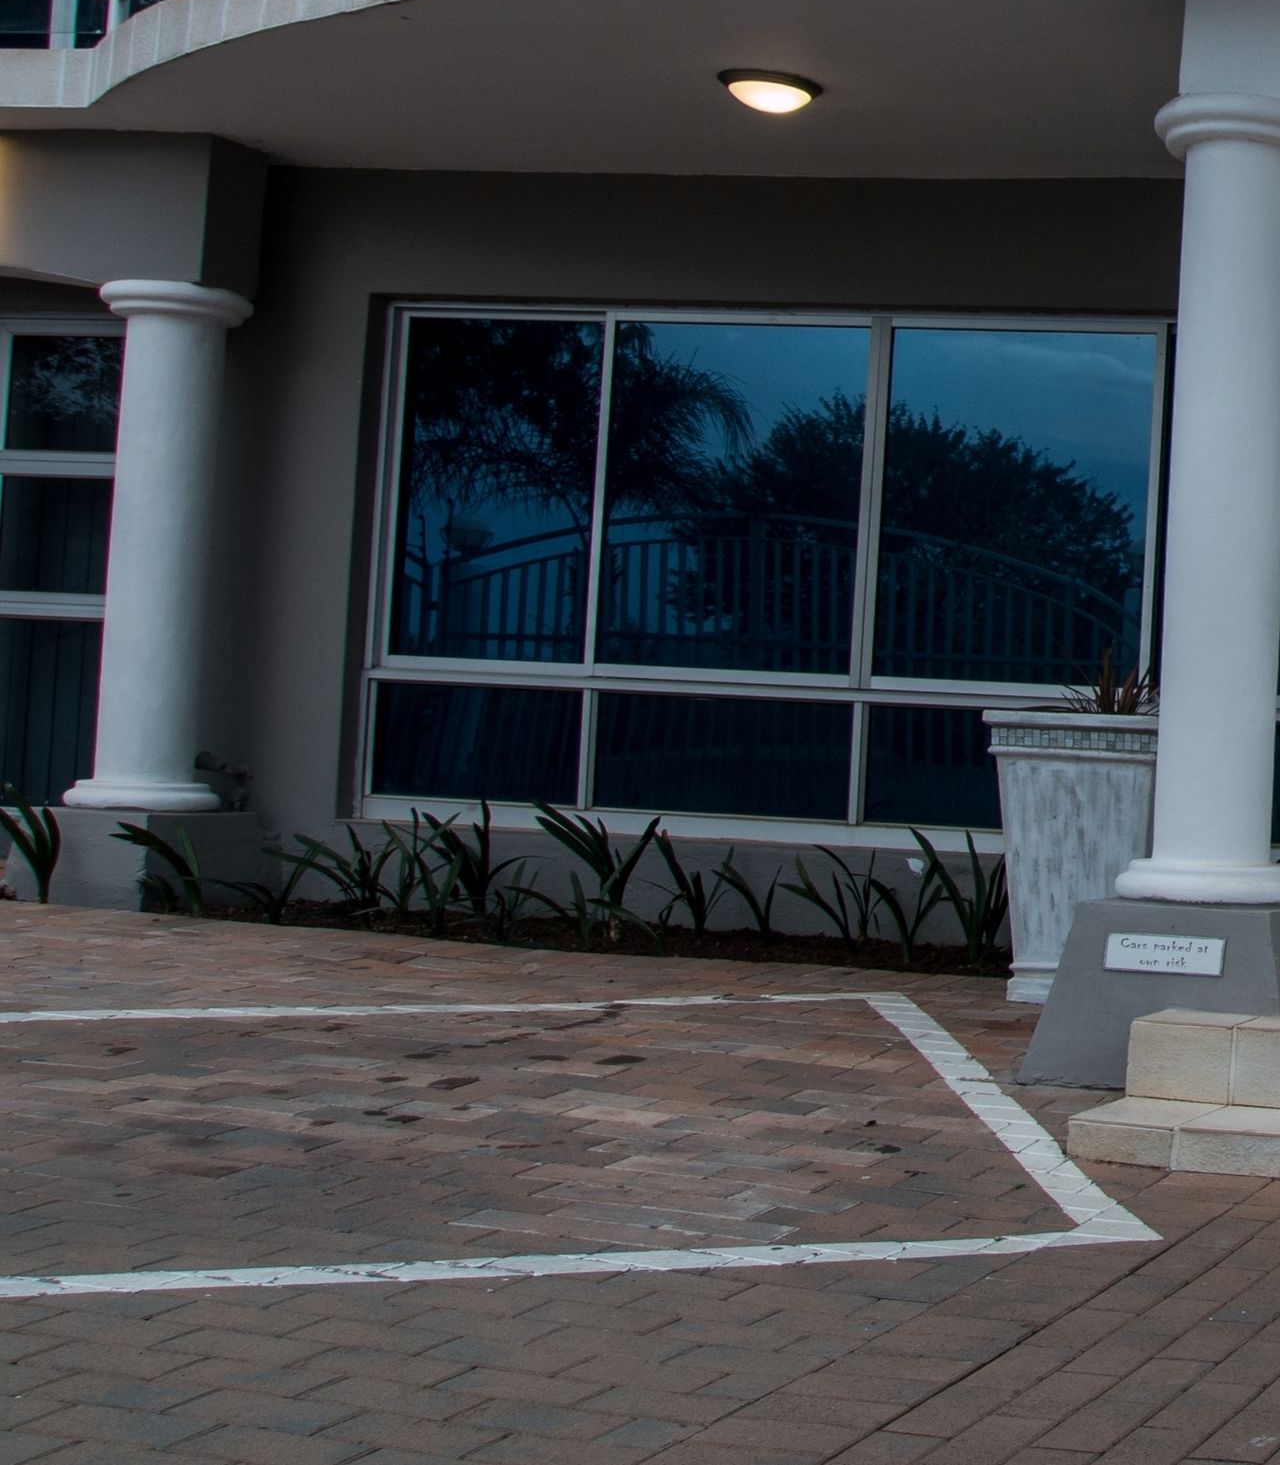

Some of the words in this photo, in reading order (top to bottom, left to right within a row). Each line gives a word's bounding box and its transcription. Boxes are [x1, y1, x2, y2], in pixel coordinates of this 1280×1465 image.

[1120, 937, 1148, 950] Cars
[1153, 940, 1192, 952] parked
[1197, 945, 1208, 954] at
[1139, 958, 1160, 966] own
[1166, 957, 1187, 968] risk
